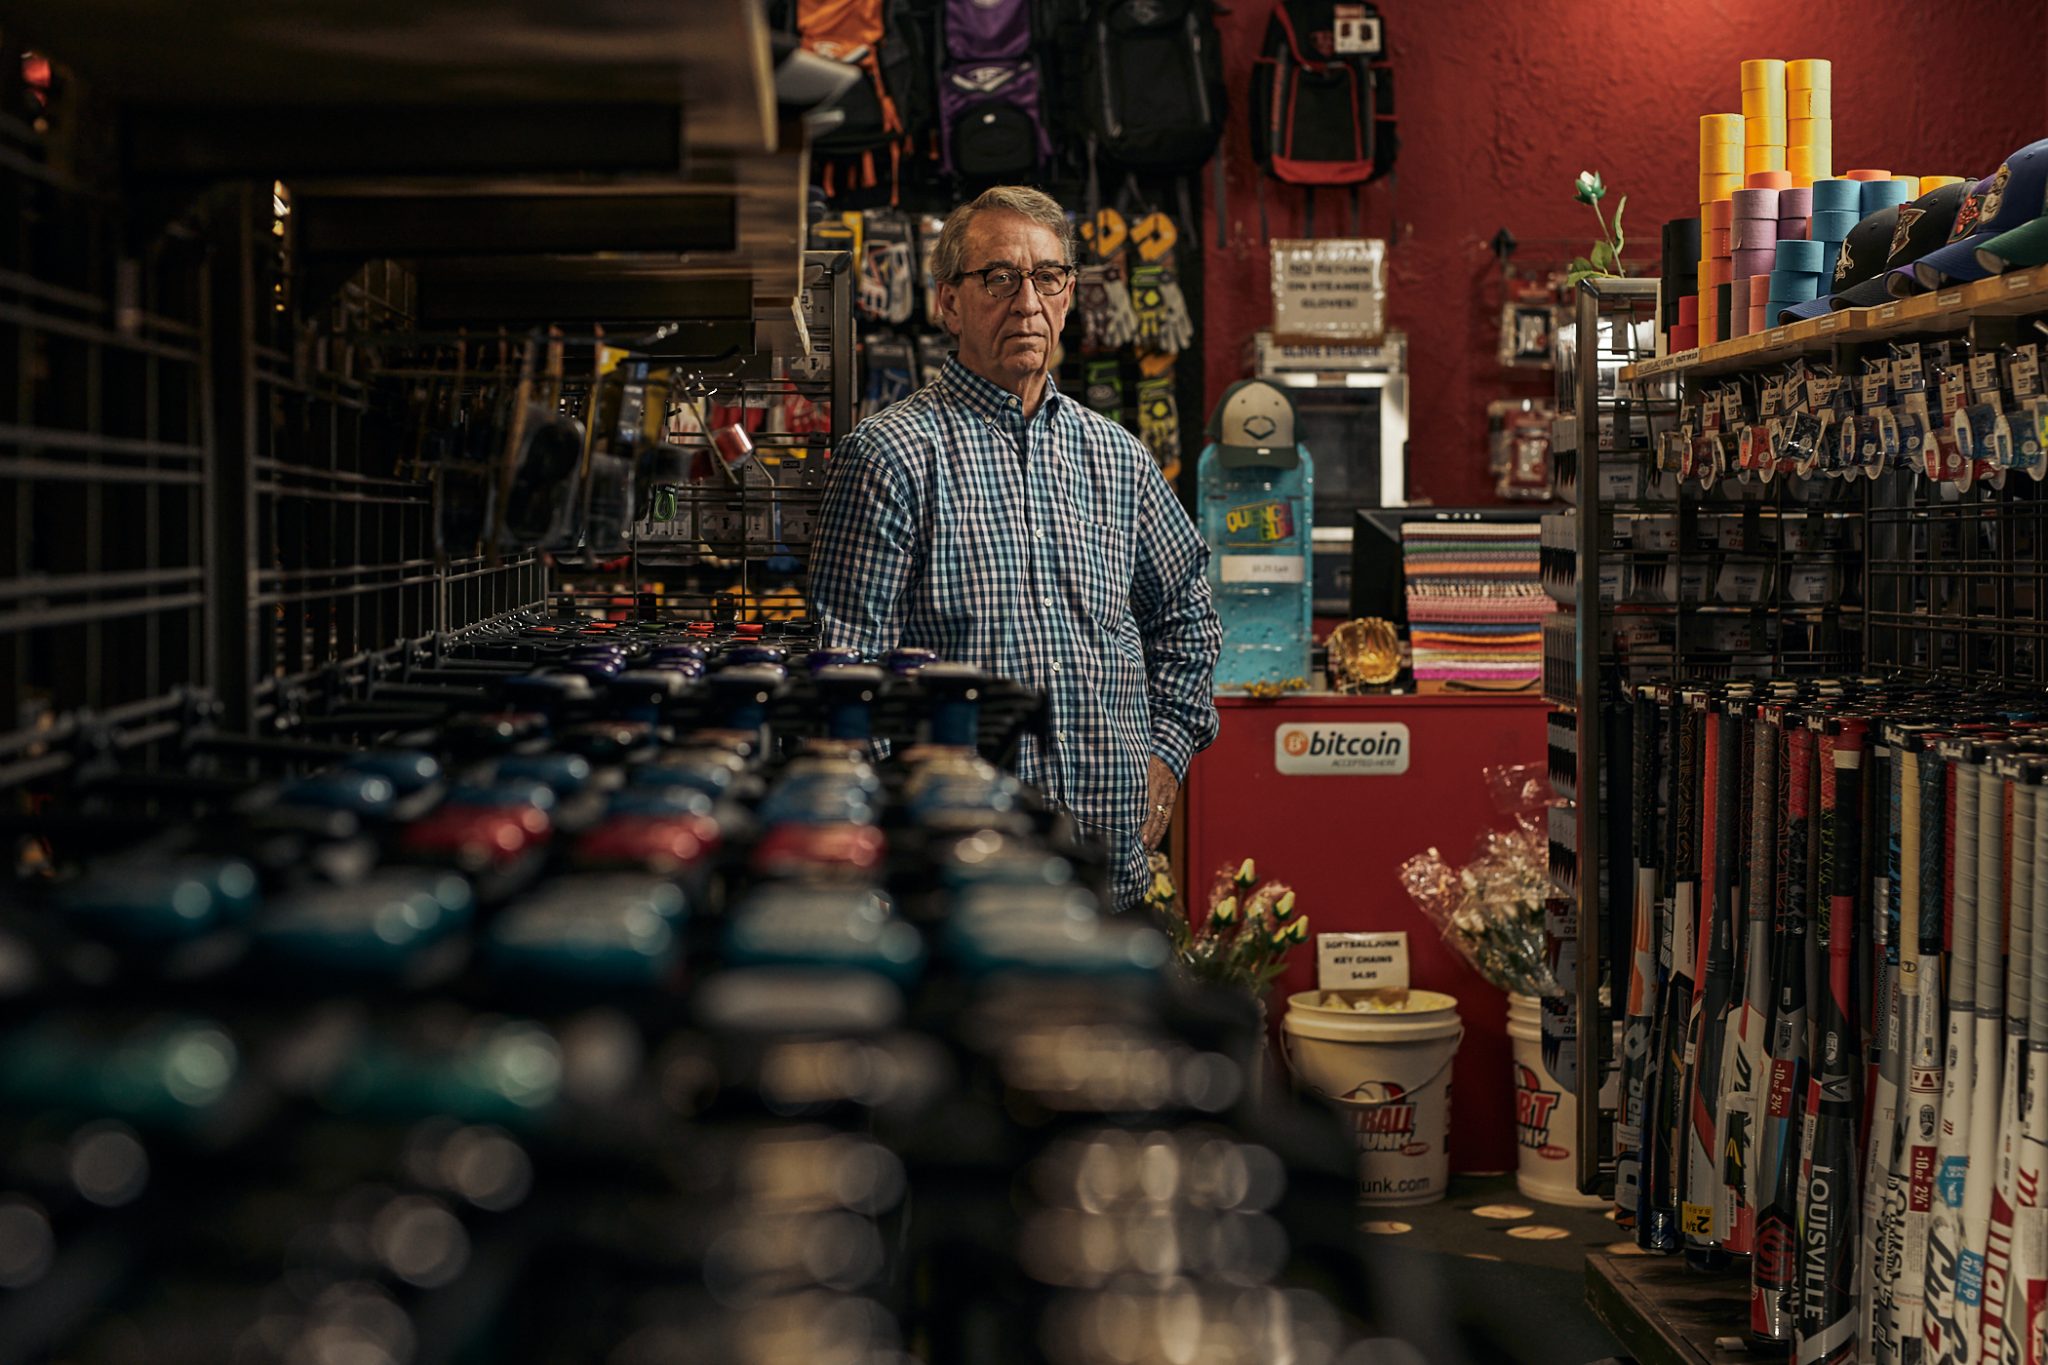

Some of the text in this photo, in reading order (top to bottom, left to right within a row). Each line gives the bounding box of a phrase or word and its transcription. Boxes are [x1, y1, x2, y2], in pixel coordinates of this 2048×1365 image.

[1309, 731, 1401, 756] bitcoin
[1333, 956, 1353, 965] KEY
[1803, 1164, 1831, 1322] LOUISVILLE
